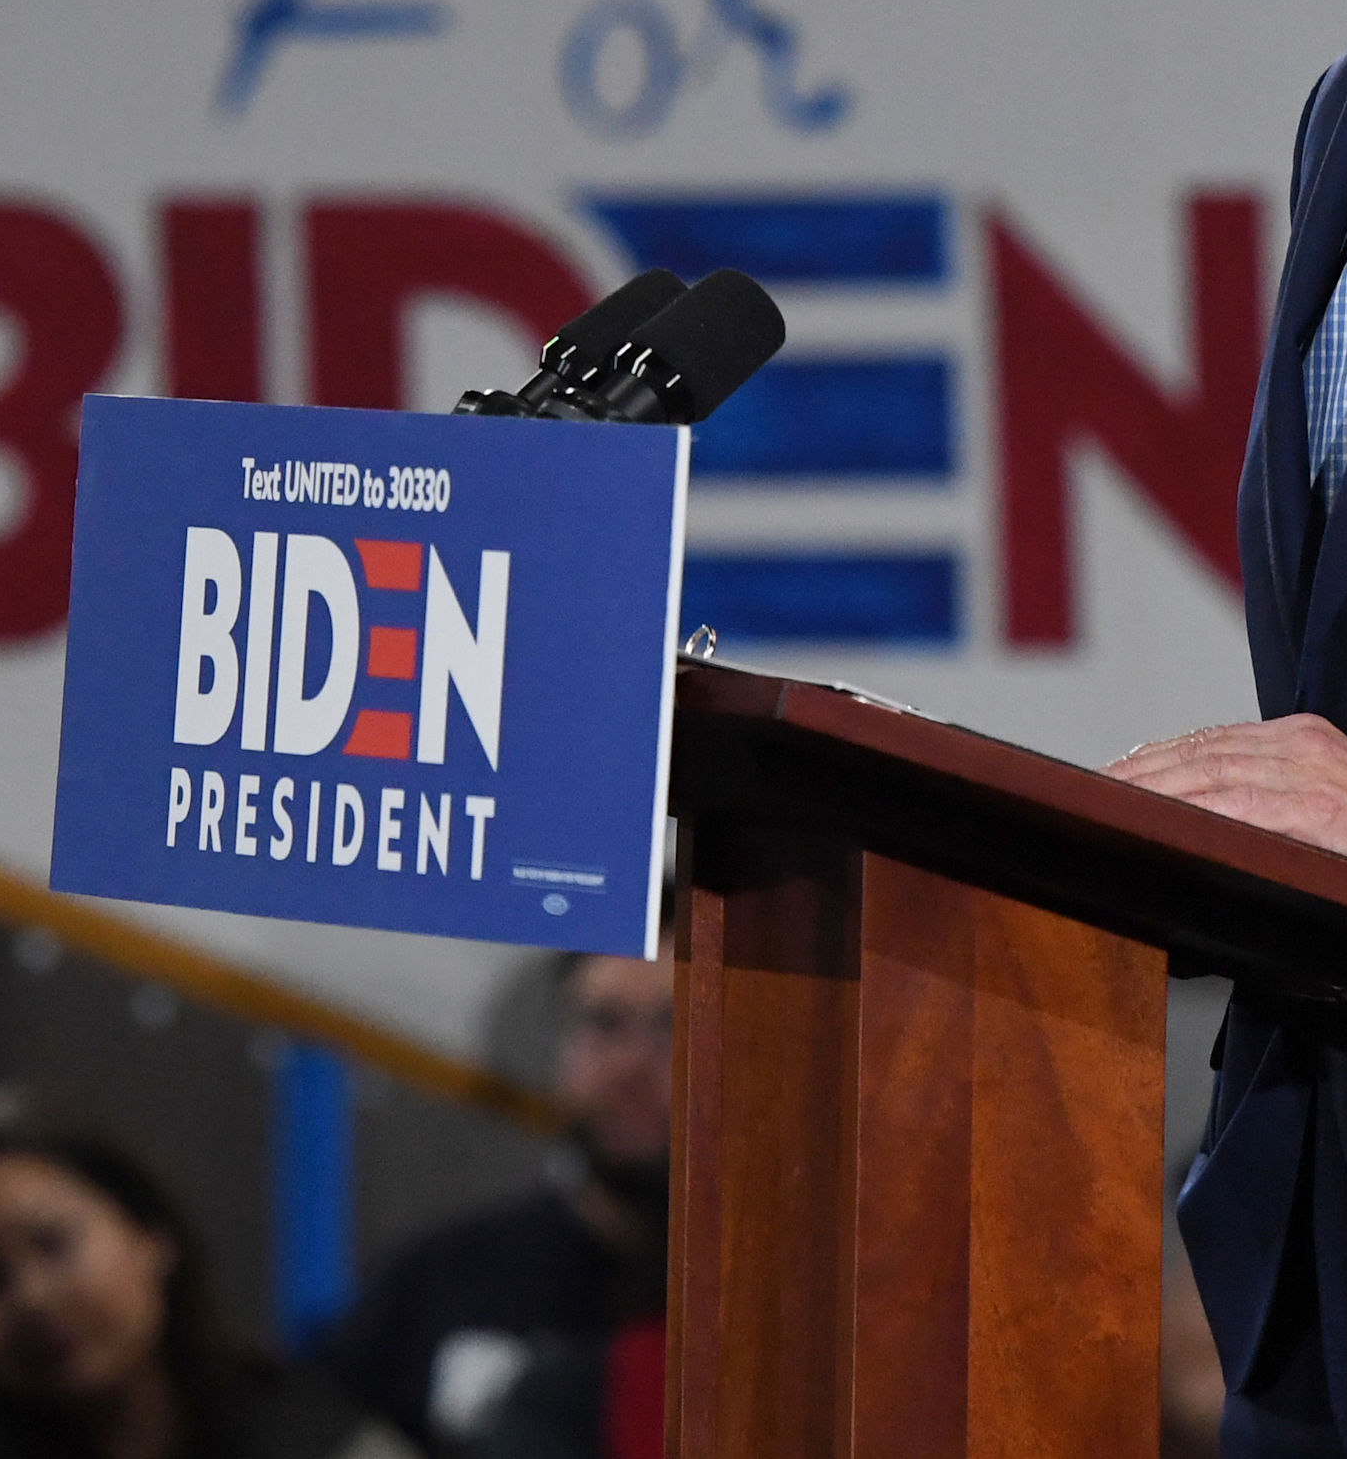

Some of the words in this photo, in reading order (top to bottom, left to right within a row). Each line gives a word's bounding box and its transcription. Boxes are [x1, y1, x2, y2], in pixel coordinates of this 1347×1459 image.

[241, 457, 282, 502] Text
[284, 460, 361, 506] UNITED
[363, 468, 385, 509] to
[386, 465, 451, 513] 30330
[172, 526, 511, 773] BIDEN
[165, 767, 496, 881] PRESIDENT
